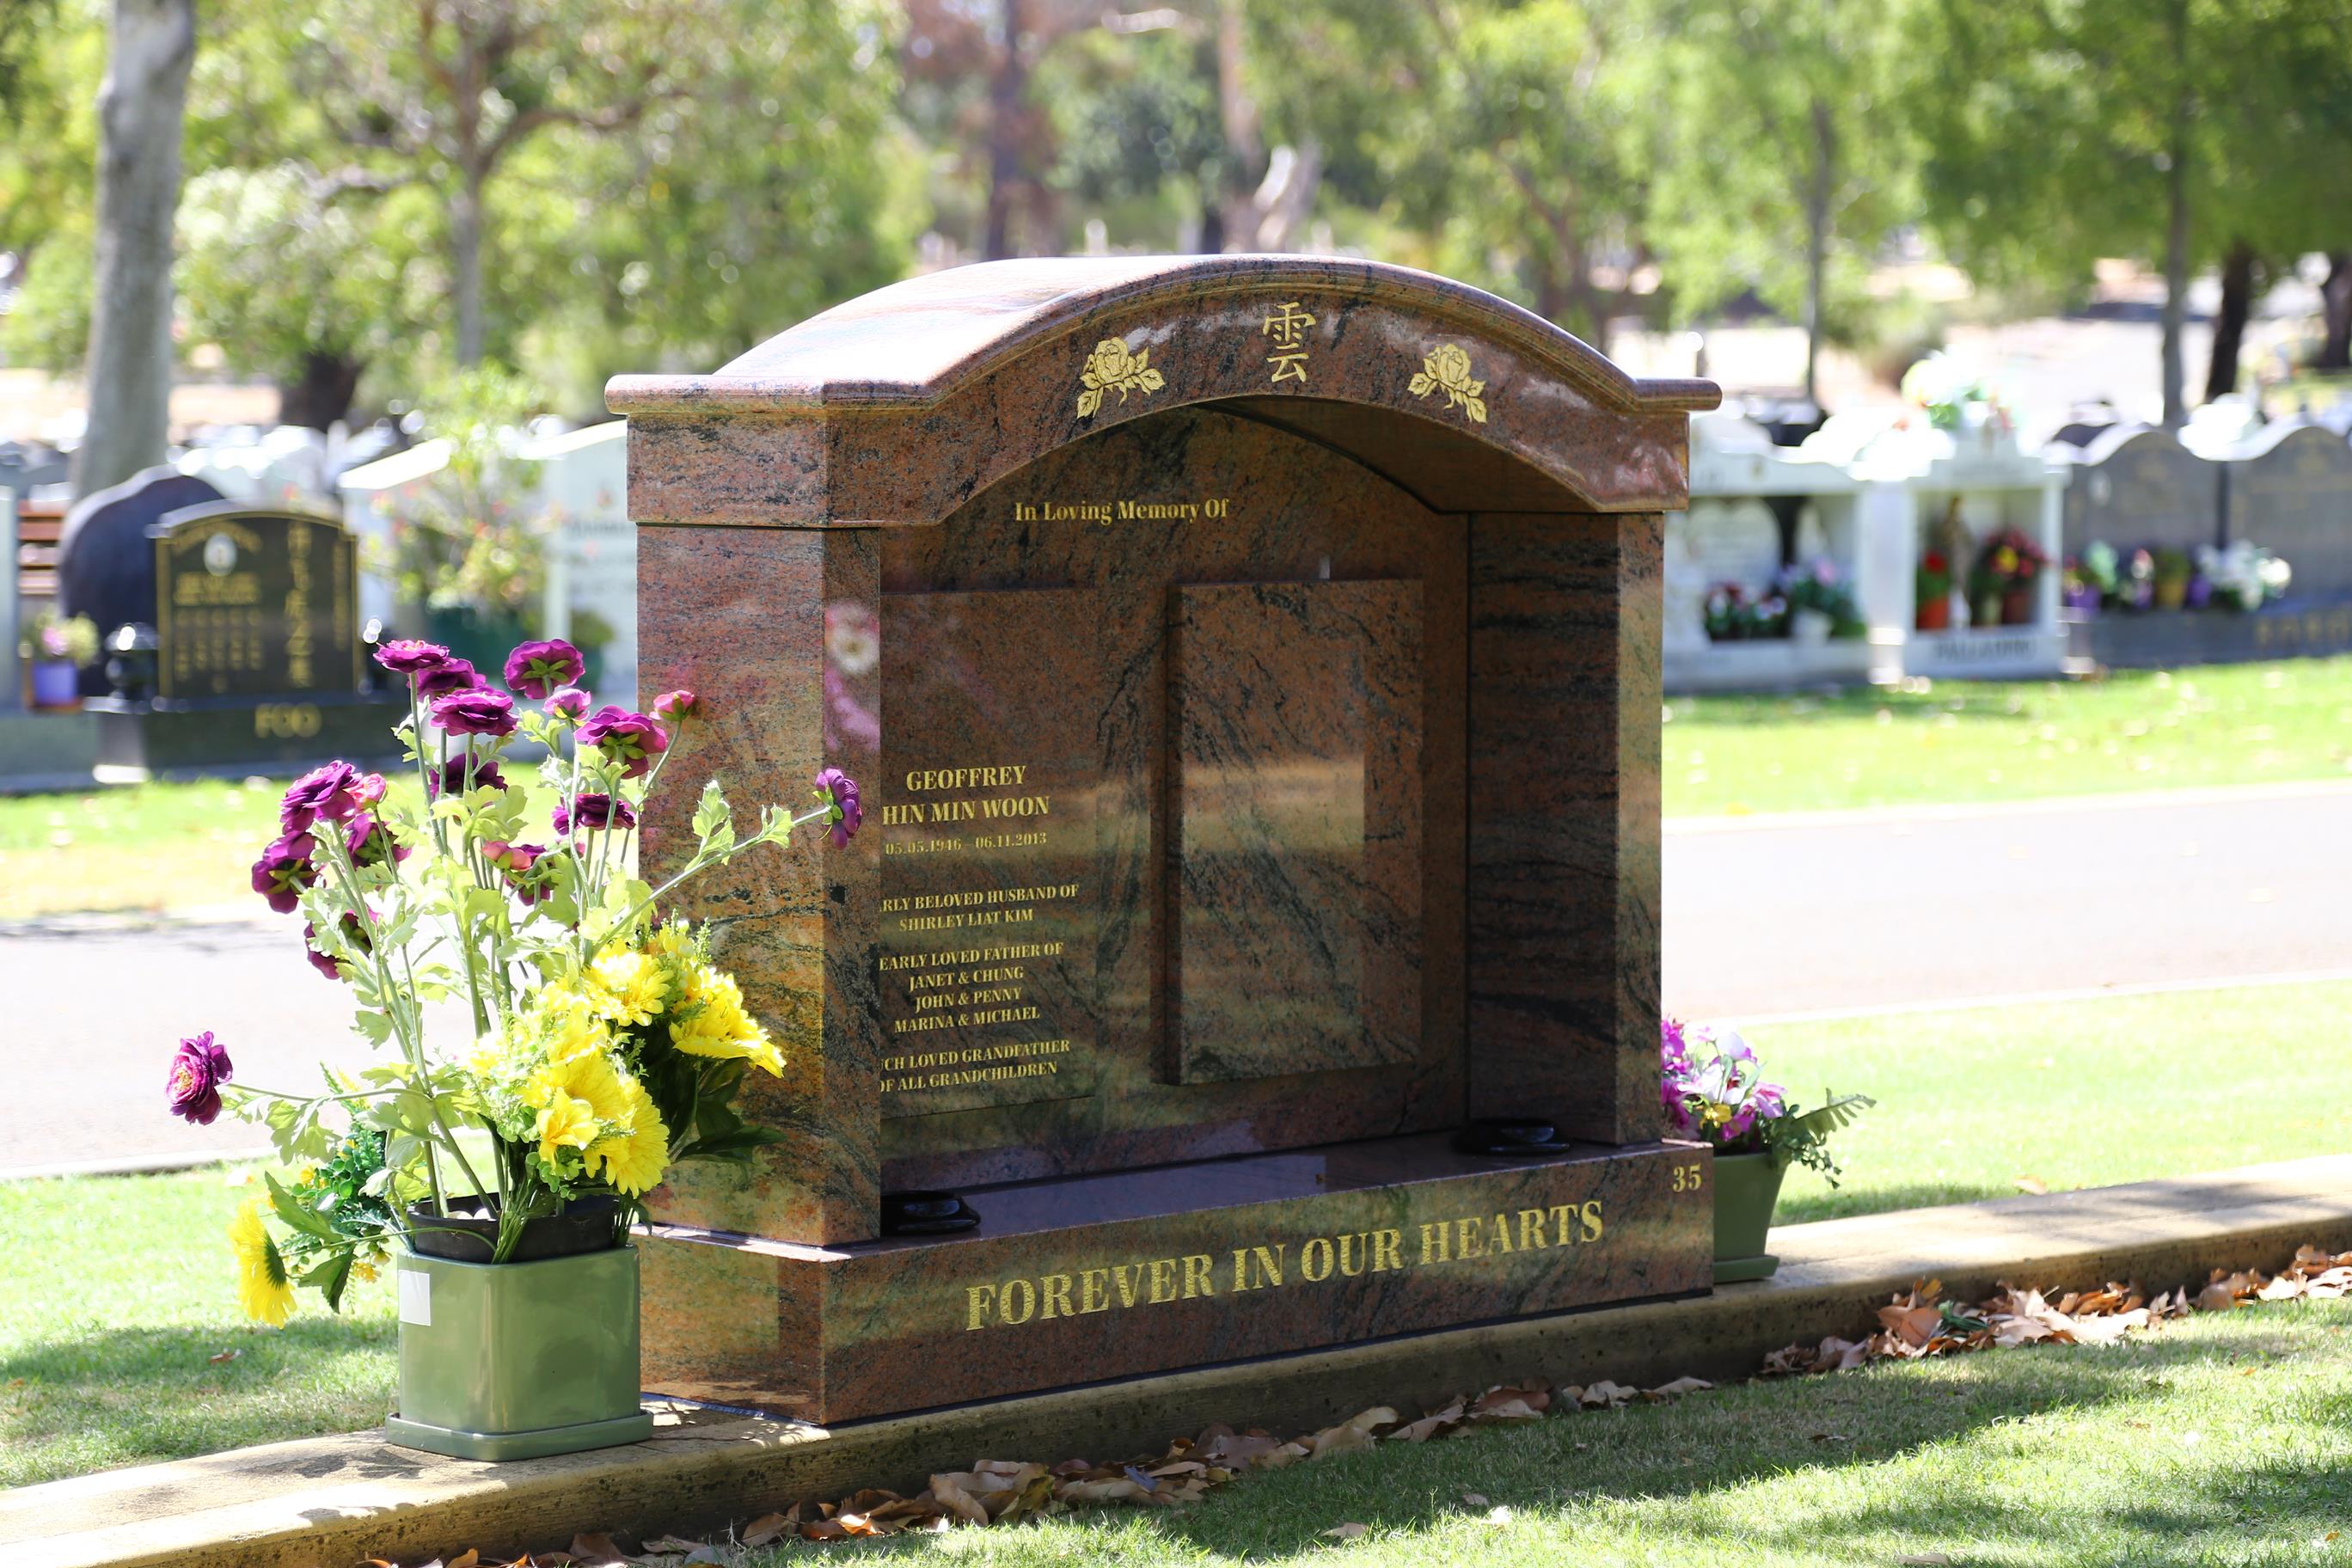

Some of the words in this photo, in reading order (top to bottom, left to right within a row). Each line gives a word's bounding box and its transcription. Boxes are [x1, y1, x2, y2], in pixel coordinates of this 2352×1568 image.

[1263, 301, 1316, 383] 雲
[1015, 501, 1038, 521] In
[1044, 501, 1112, 525] Loving
[1118, 499, 1200, 523] Memory
[1204, 499, 1229, 518] Of
[906, 765, 1026, 792] GEOFFREY
[931, 800, 976, 823] MIN
[983, 796, 1050, 818] WOON
[885, 837, 962, 855] 05.05.1946
[976, 831, 1046, 848] 06.11.2013
[879, 897, 910, 912] RLY
[915, 891, 983, 910] BELOVED
[988, 886, 1057, 903] HUSBAND
[1060, 884, 1080, 898] OF
[899, 915, 965, 932] SHIRLEY
[968, 910, 1001, 927] LIAT
[1004, 908, 1033, 922] KIM
[931, 949, 980, 966] LOVED
[983, 944, 1040, 961] FATHER
[1044, 941, 1064, 956] OF
[909, 972, 955, 993] JANET
[958, 971, 970, 984] &
[973, 966, 1025, 983] CHUNG
[915, 994, 955, 1014] JOHN
[958, 993, 970, 1006] &
[973, 987, 1022, 1004] PENNY
[894, 1015, 955, 1033] MARINA
[958, 1014, 969, 1026] &
[972, 1007, 1040, 1025] MICHAEL
[909, 1051, 959, 1069] LOVED
[962, 1039, 1070, 1063] GRANDFATHER
[897, 1075, 927, 1092] ALL
[929, 1062, 1057, 1088] GRANDCHILDREN
[1671, 1163, 1703, 1193] 35
[965, 1255, 1216, 1332] FOREVER
[1232, 1245, 1286, 1294] IN
[1300, 1228, 1405, 1283] OUR
[1419, 1200, 1605, 1265] HEARTS
